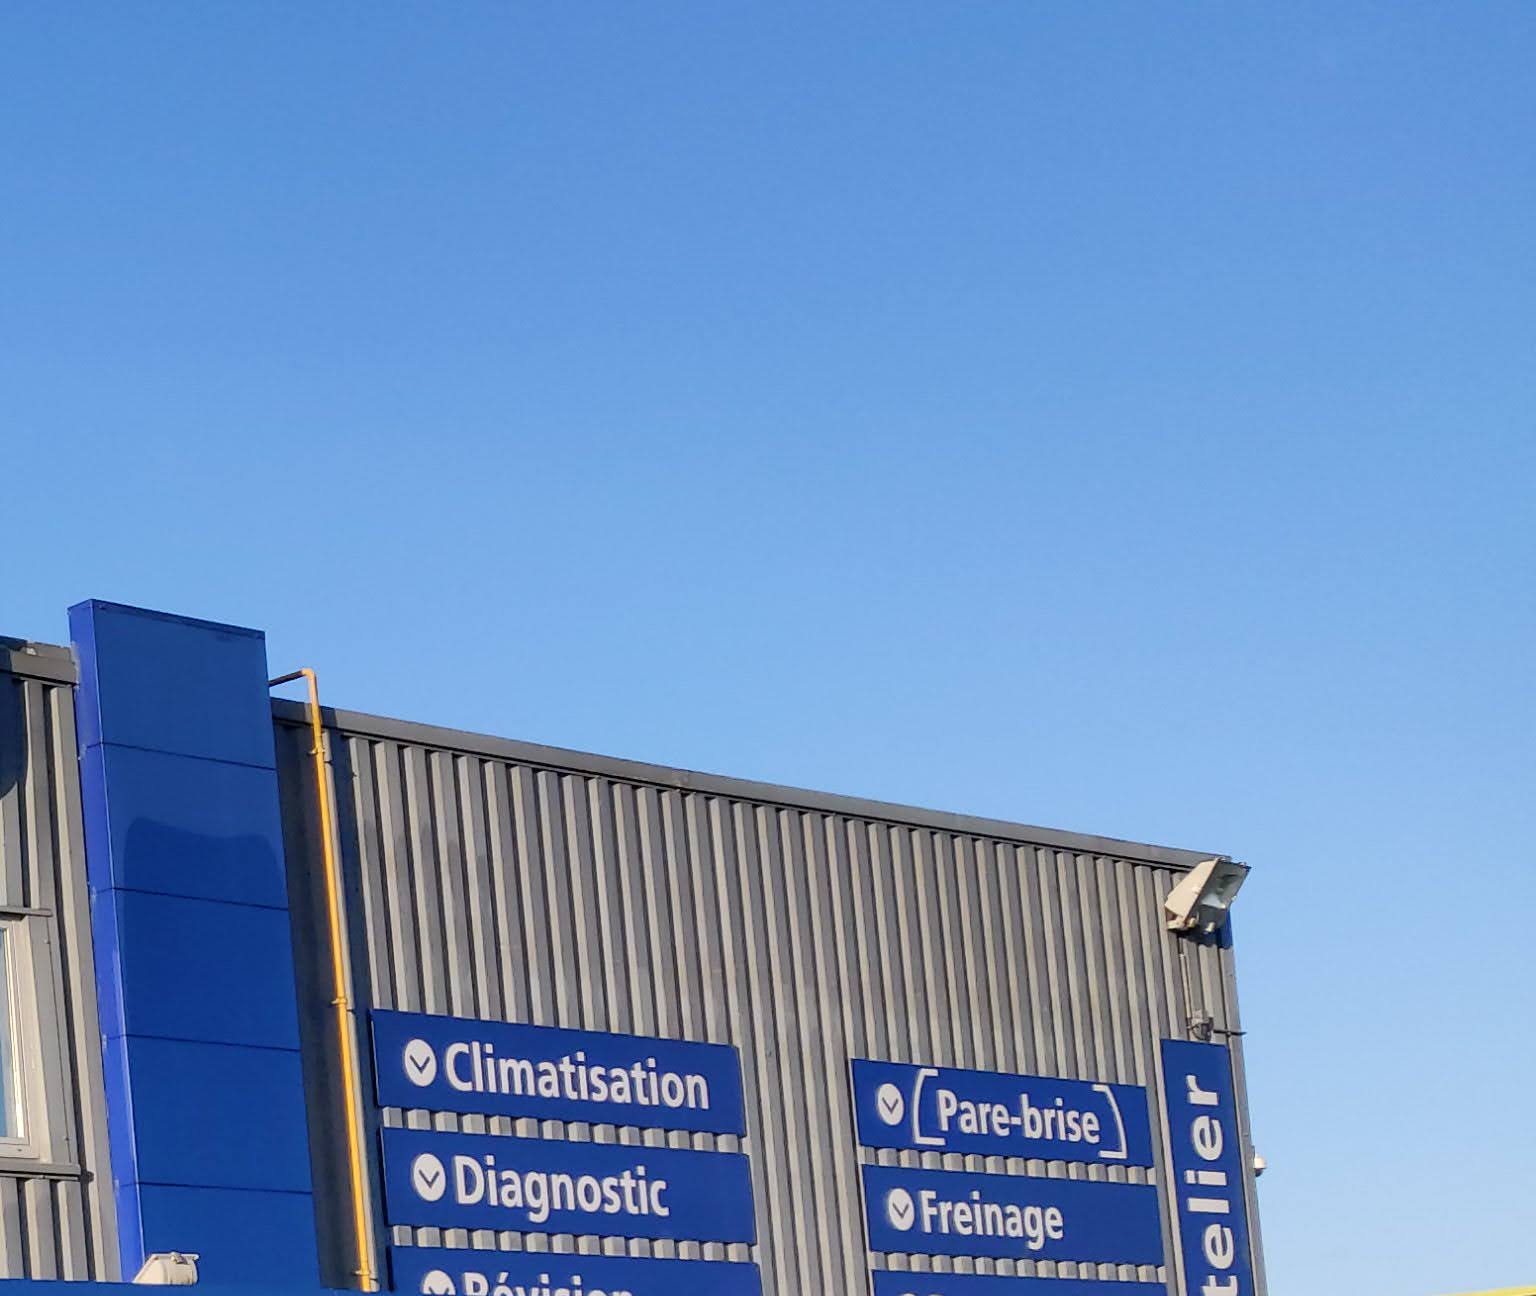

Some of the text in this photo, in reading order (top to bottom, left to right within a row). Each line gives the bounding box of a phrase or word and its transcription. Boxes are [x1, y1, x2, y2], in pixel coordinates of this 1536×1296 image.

[445, 1041, 710, 1110] Climatisation
[937, 1089, 1100, 1144] Pare-brise
[454, 1155, 670, 1224] Diagnostic
[919, 1189, 1065, 1251] Freinage
